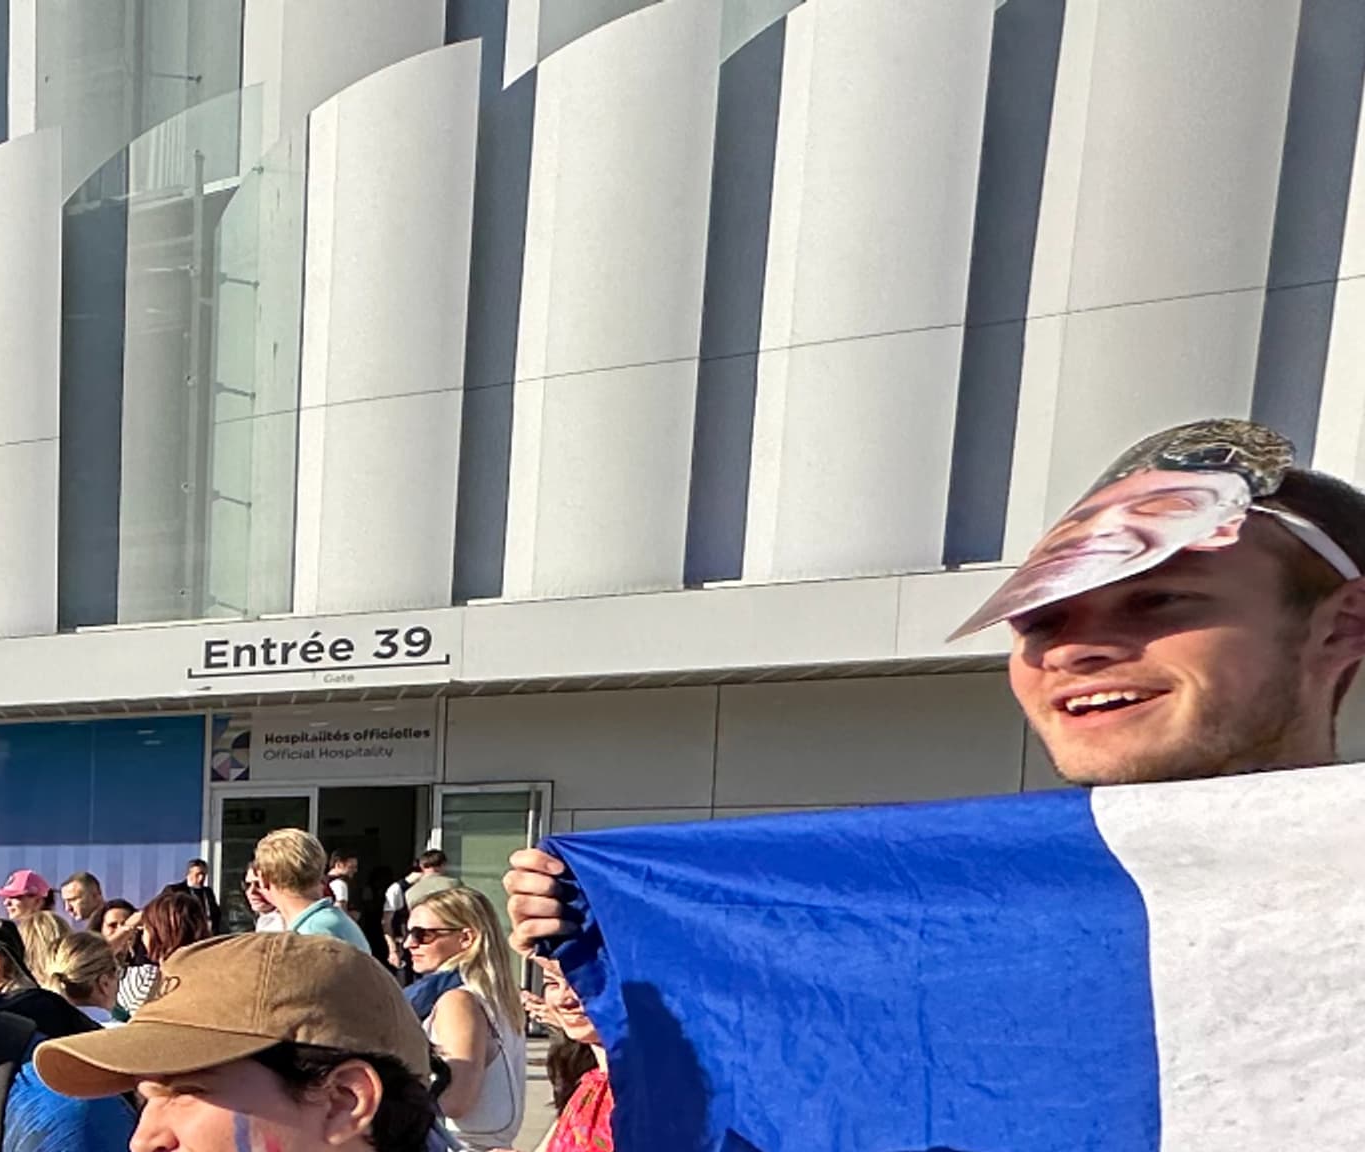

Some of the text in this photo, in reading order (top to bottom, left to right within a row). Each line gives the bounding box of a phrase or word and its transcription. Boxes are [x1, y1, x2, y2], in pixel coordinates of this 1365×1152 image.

[204, 626, 433, 669] Entrée 39
[323, 673, 355, 684] Gate
[264, 727, 431, 748] Hospitalités officielles
[263, 746, 394, 761] Official Hospitality
